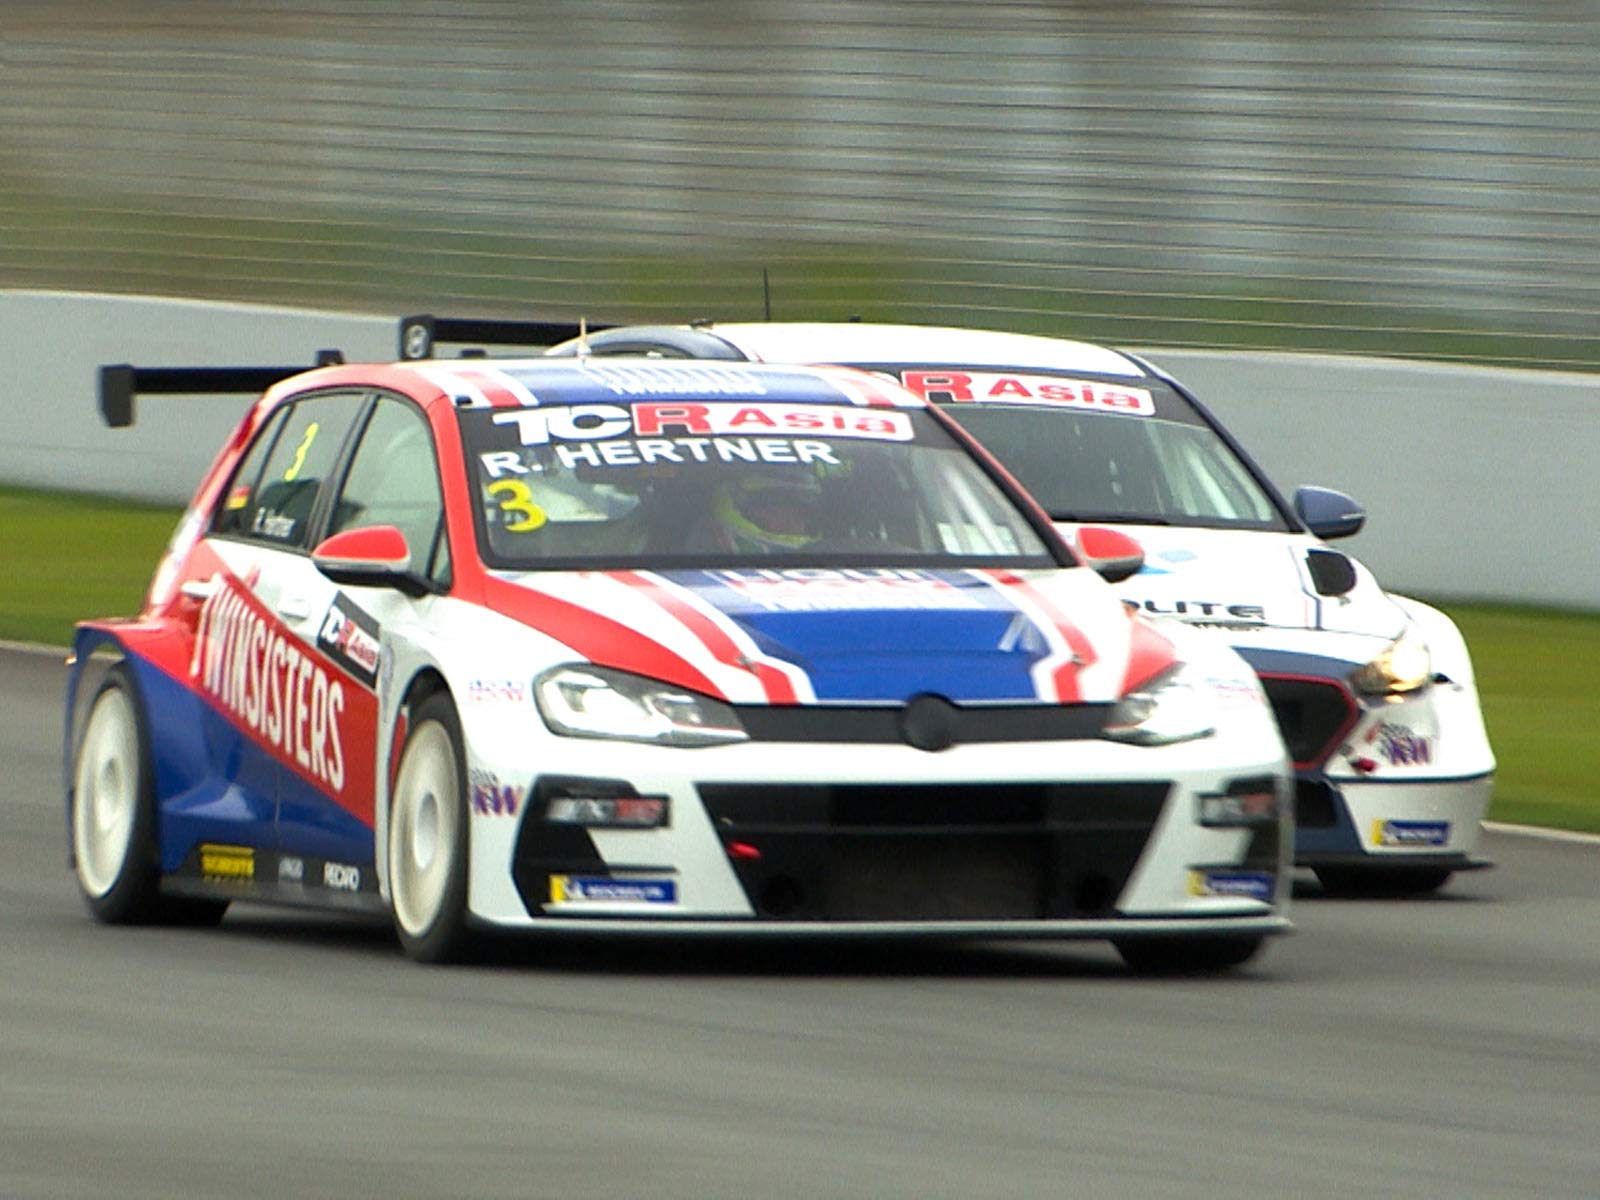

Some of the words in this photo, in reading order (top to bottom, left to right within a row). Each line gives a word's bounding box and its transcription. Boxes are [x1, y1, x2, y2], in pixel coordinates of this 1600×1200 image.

[988, 378, 1141, 409] Asia
[493, 403, 714, 446] TCR
[729, 407, 899, 436] Asia
[480, 451, 544, 478] R.
[556, 437, 841, 469] HERTNER
[487, 479, 549, 533] 3
